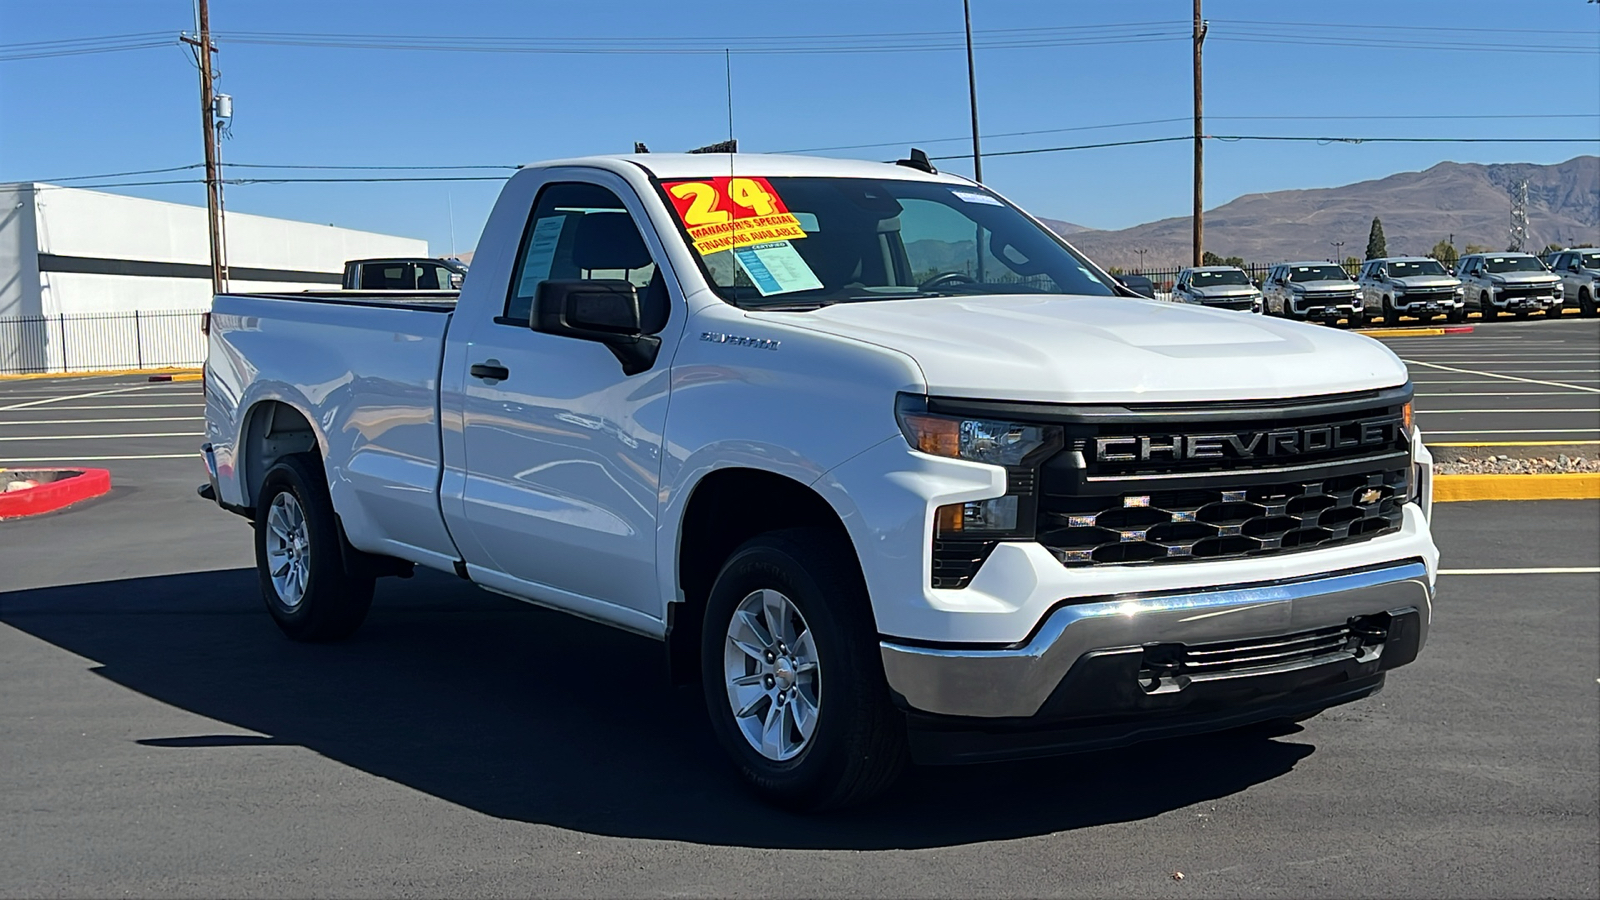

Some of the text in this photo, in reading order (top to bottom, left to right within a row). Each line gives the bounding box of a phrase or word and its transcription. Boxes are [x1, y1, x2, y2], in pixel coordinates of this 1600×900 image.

[670, 178, 777, 225] 24
[691, 215, 795, 239] MANAGER'S SPECIAL
[698, 233, 751, 252] FINANCING
[750, 226, 801, 241] AVAILABLE
[752, 241, 786, 250] CERTIFIED
[1096, 419, 1401, 462] CHEVROLET
